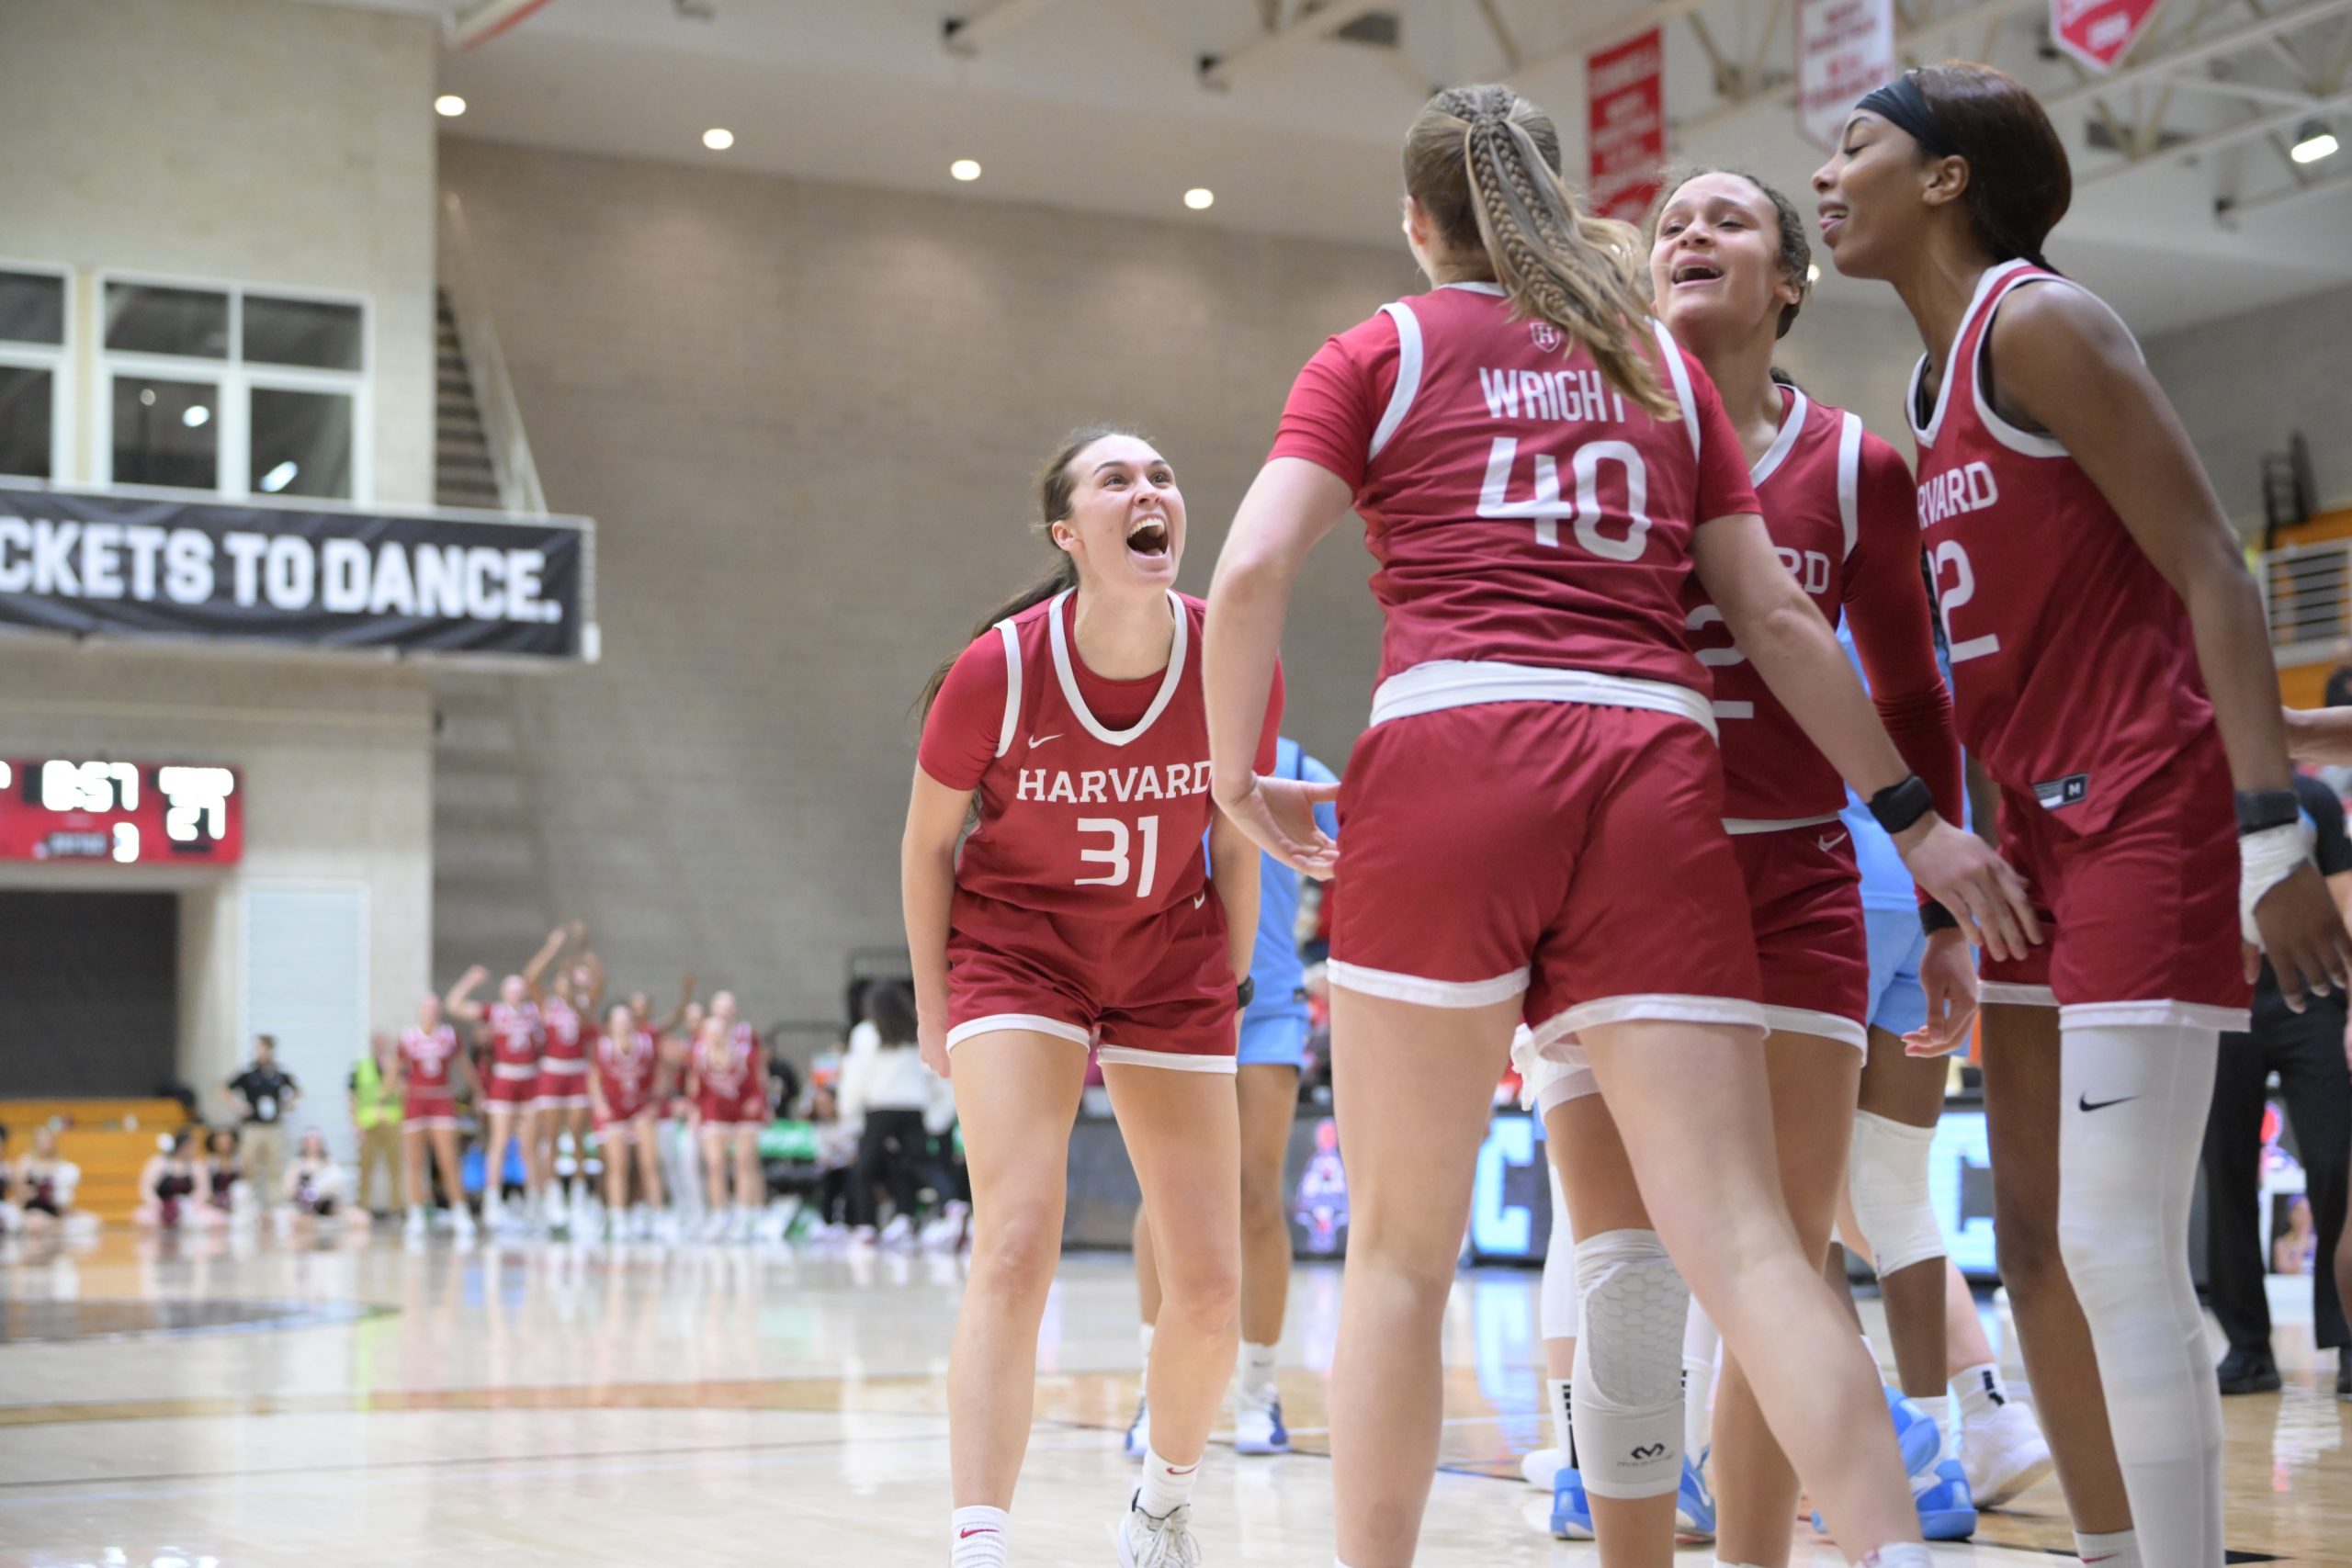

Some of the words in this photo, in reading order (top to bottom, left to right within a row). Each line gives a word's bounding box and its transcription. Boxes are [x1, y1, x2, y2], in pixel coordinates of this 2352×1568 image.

[1476, 436, 1653, 563] 40
[0, 516, 215, 605] CKETS
[223, 532, 315, 610] TO
[322, 538, 562, 623] DANCE.
[1926, 539, 2000, 664] 2
[1016, 760, 1213, 804] HARVARD
[1073, 814, 1159, 898] 31
